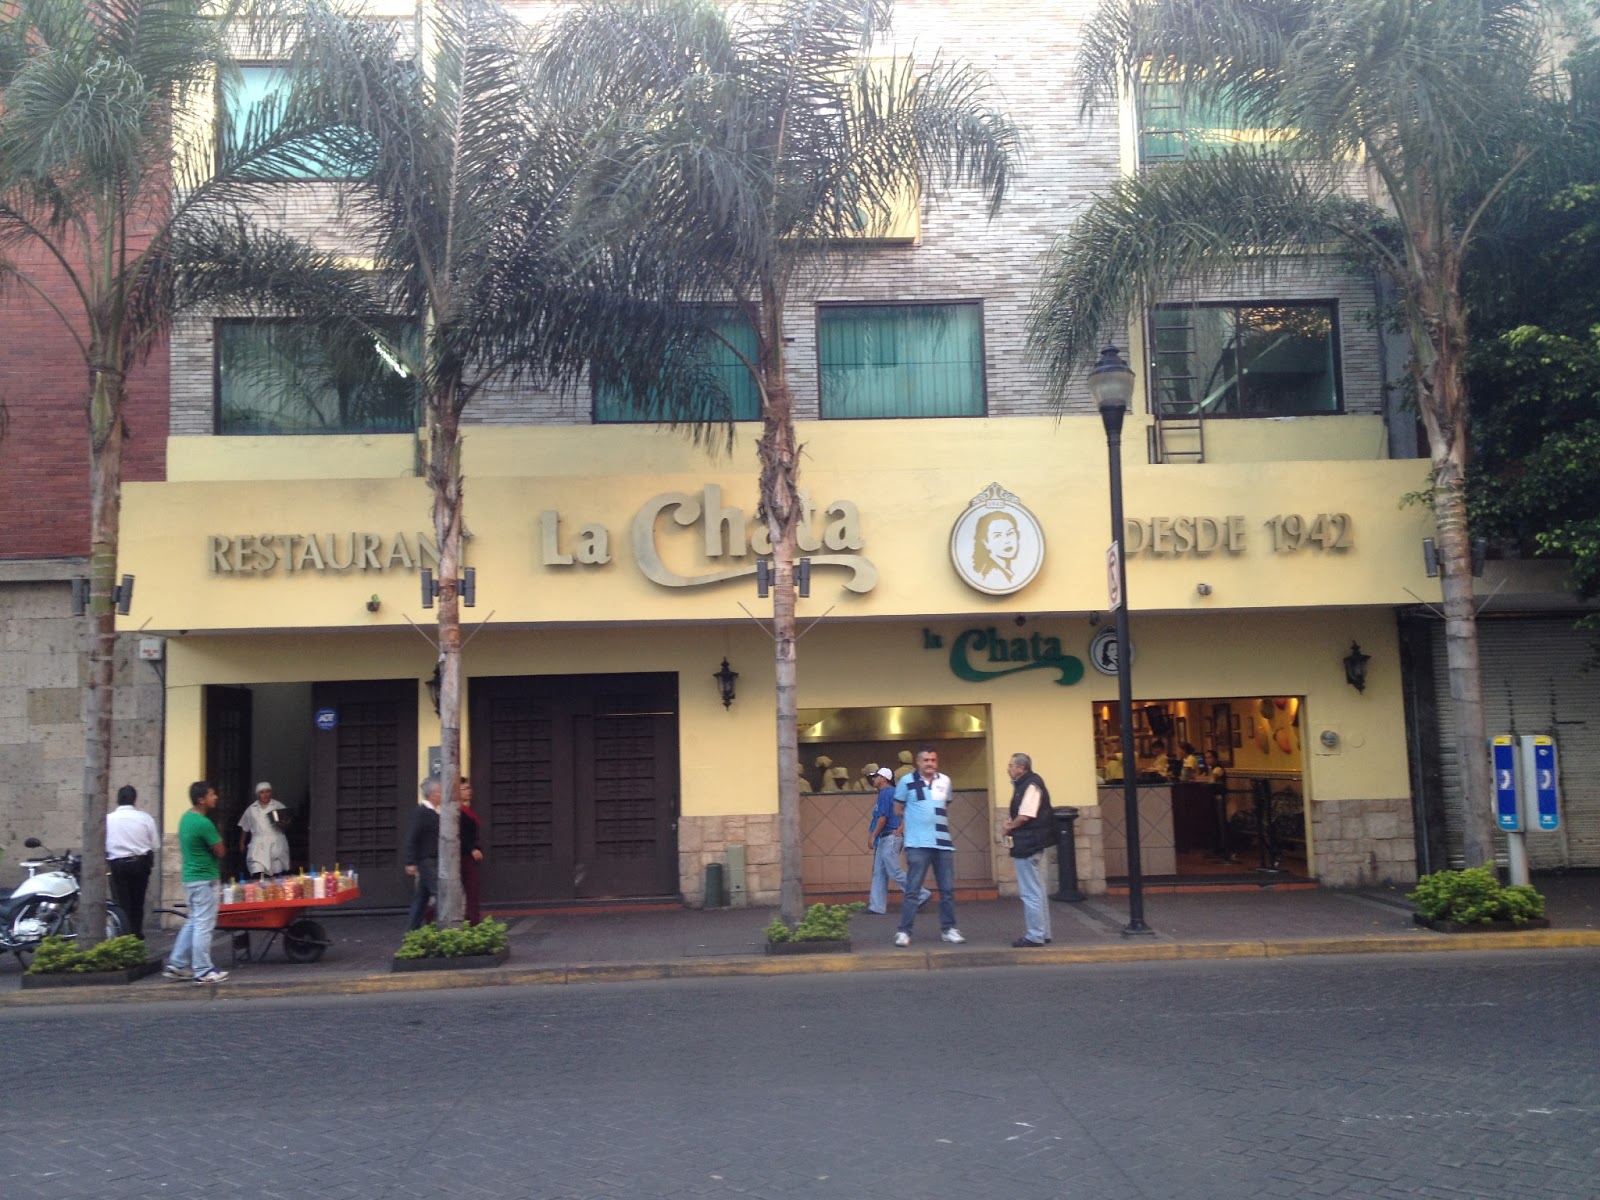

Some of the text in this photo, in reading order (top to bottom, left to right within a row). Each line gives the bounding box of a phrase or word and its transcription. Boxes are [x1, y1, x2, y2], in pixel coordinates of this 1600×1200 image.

[541, 511, 612, 565] La
[1124, 513, 1354, 553] DESDE 1942
[950, 627, 1085, 686] Chata
